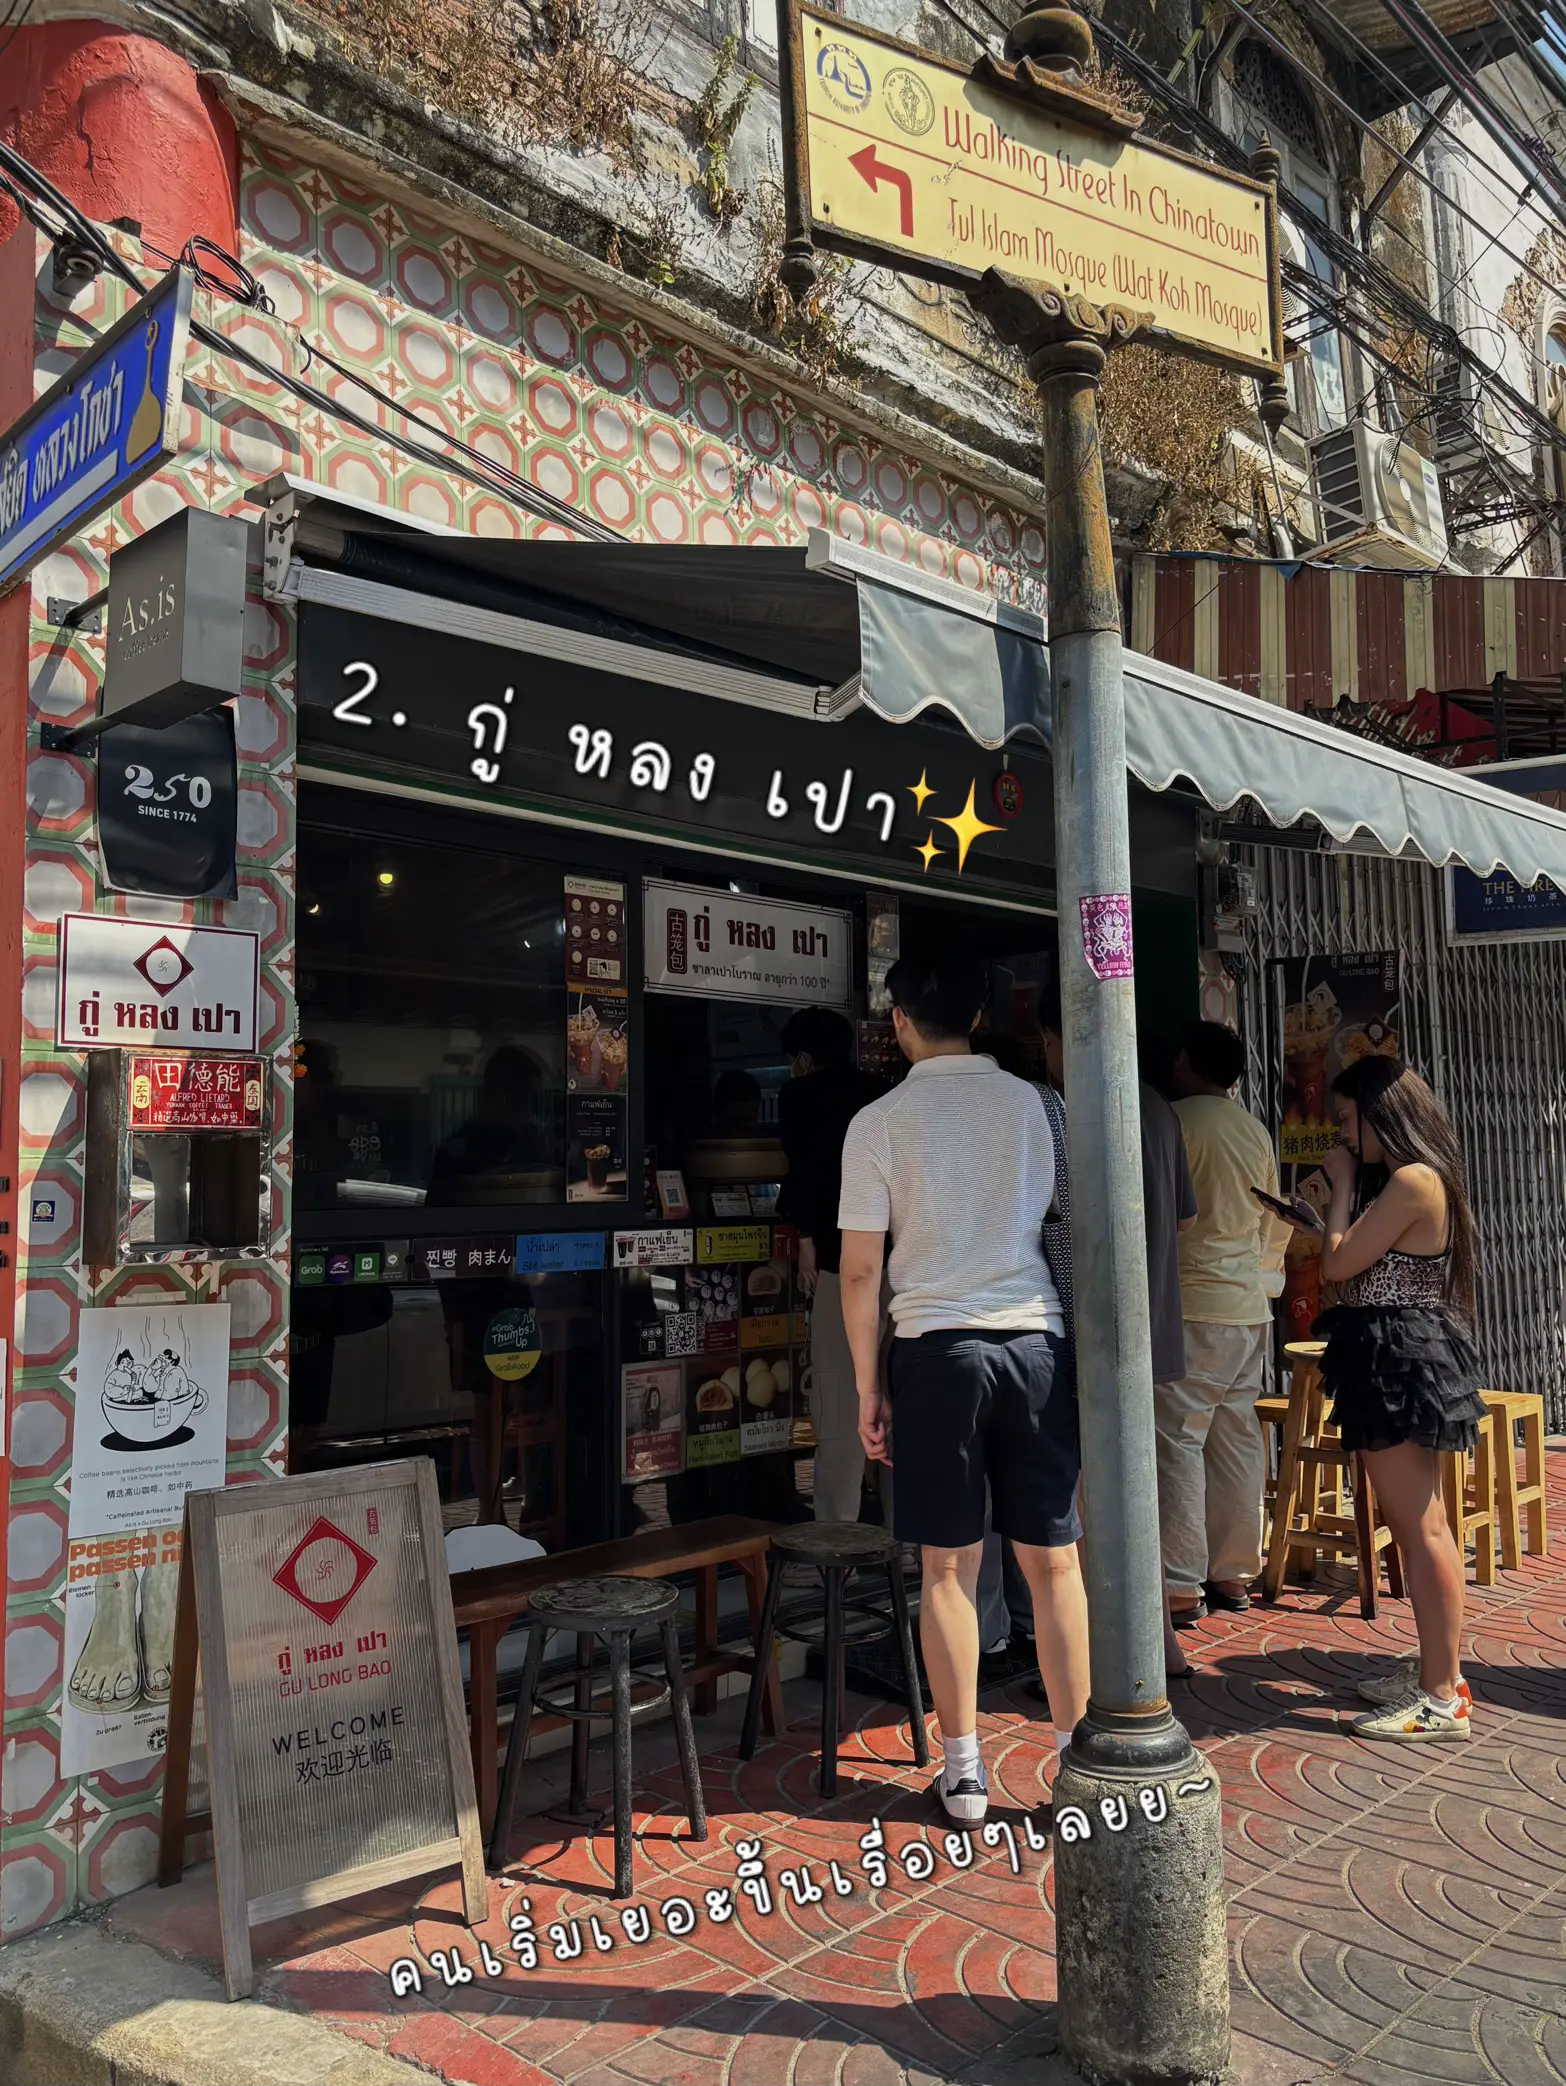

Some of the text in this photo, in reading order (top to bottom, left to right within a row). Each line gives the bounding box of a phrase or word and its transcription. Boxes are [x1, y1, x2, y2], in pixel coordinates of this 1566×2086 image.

[943, 105, 1260, 258] Walking Street In Chinatown
[948, 197, 1263, 342] Tul Islam Mosque (Wat Koh Mosque)
[118, 574, 175, 642] As.is
[124, 764, 212, 808] 250
[138, 805, 197, 823] SINCE 1774
[1482, 880, 1516, 895] THE
[693, 906, 828, 958] กู่ หลง เปา
[692, 964, 761, 981] ซาลาเปาโบราณ
[764, 972, 798, 988] อายุกว่า
[800, 975, 817, 988] 100
[1349, 968, 1365, 976] LONG
[1366, 967, 1380, 975] BAO
[78, 990, 241, 1037] กู่ หลง เปา
[170, 1092, 197, 1103] ALFRED
[189, 1101, 209, 1109] COFFEE
[638, 1230, 678, 1245] กาแฟเย็น
[426, 1248, 457, 1268] 찐빵
[468, 1248, 511, 1267] 肉まん
[540, 1260, 564, 1270] water
[301, 1264, 323, 1275] Grab
[491, 1325, 530, 1345] Thumbs
[515, 1336, 527, 1348] Up
[495, 1361, 530, 1372] GrabFood
[122, 1465, 153, 1475] selectively
[155, 1462, 175, 1470] picked
[176, 1460, 190, 1468] from
[191, 1458, 219, 1467] mountains
[139, 1472, 163, 1480] Chinese
[106, 1481, 193, 1499] 精选高山咖啡、如中药
[145, 1506, 173, 1515] Artisanal
[70, 1534, 157, 1562] Passen
[69, 1551, 157, 1583] passen
[277, 1631, 387, 1676] กู่ หลง เปา
[279, 1660, 391, 1697] GU LONG BAO
[272, 1706, 405, 1756] WELCOME
[296, 1738, 393, 1785] 欢迎光临
